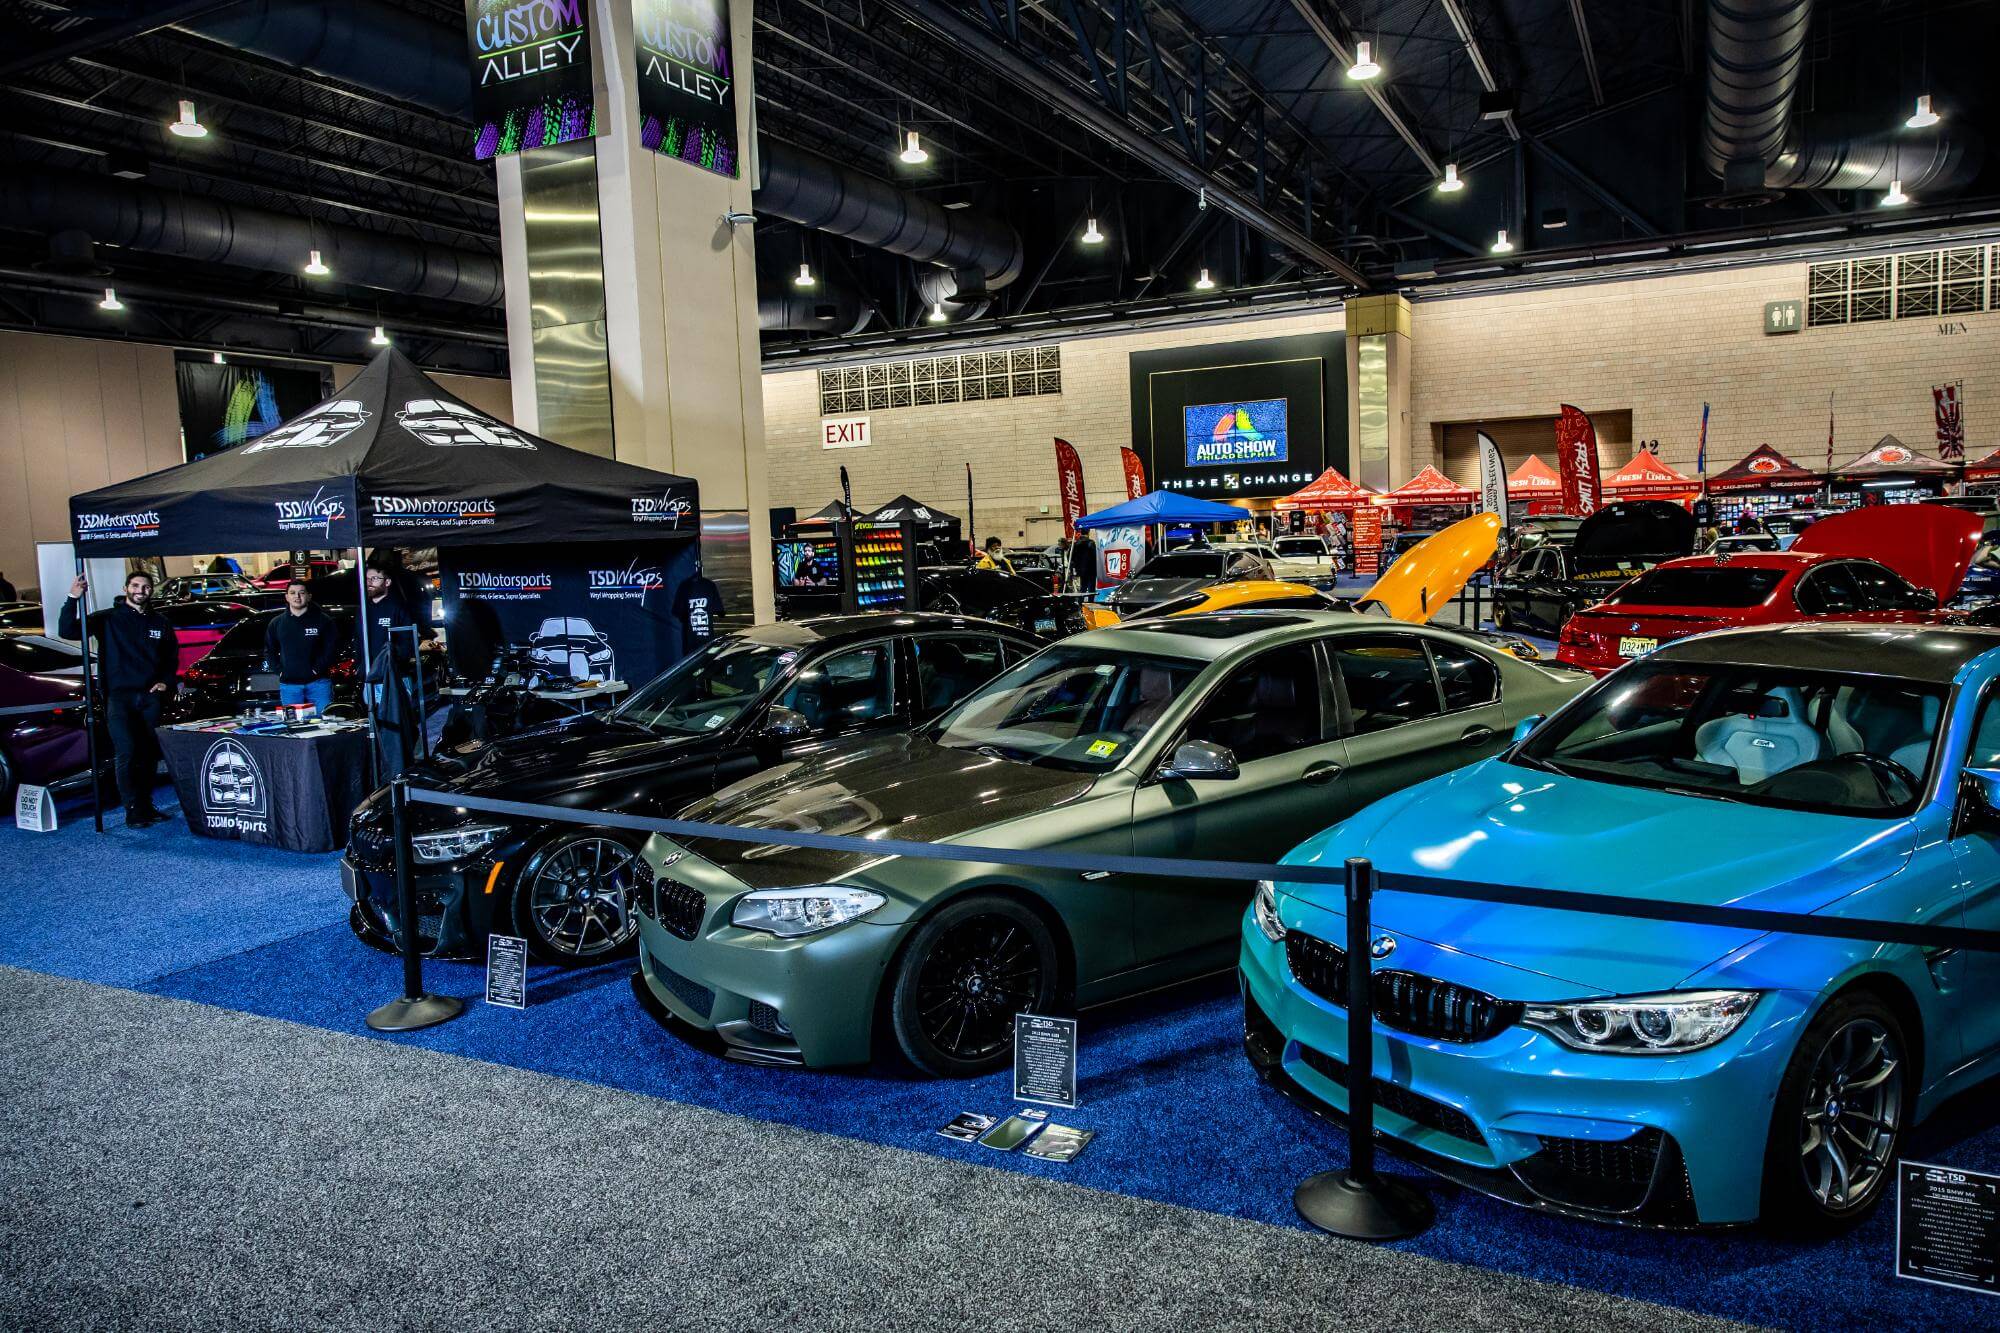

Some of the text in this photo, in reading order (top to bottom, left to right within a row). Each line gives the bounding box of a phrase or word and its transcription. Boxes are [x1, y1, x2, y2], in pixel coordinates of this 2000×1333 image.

[477, 0, 584, 51] CUSTOM
[481, 35, 581, 85] ALLEY
[645, 56, 729, 105] ALLEY
[1937, 322, 1967, 336] MEN
[826, 422, 866, 444] EXIT
[1196, 451, 1277, 461] PHILADELPHIA
[1197, 439, 1277, 456] AUTO SHOW
[1574, 441, 1592, 479] FRESH
[1162, 479, 1194, 489] THE
[371, 496, 496, 516] TSDMotorsports
[441, 518, 451, 526] and
[458, 572, 552, 590] TSDMotorsports
[689, 598, 708, 609] TSD
[1947, 1172, 1966, 1182] TSD
[1929, 1185, 1945, 1193] 2015
[1946, 1188, 1964, 1196] BMW
